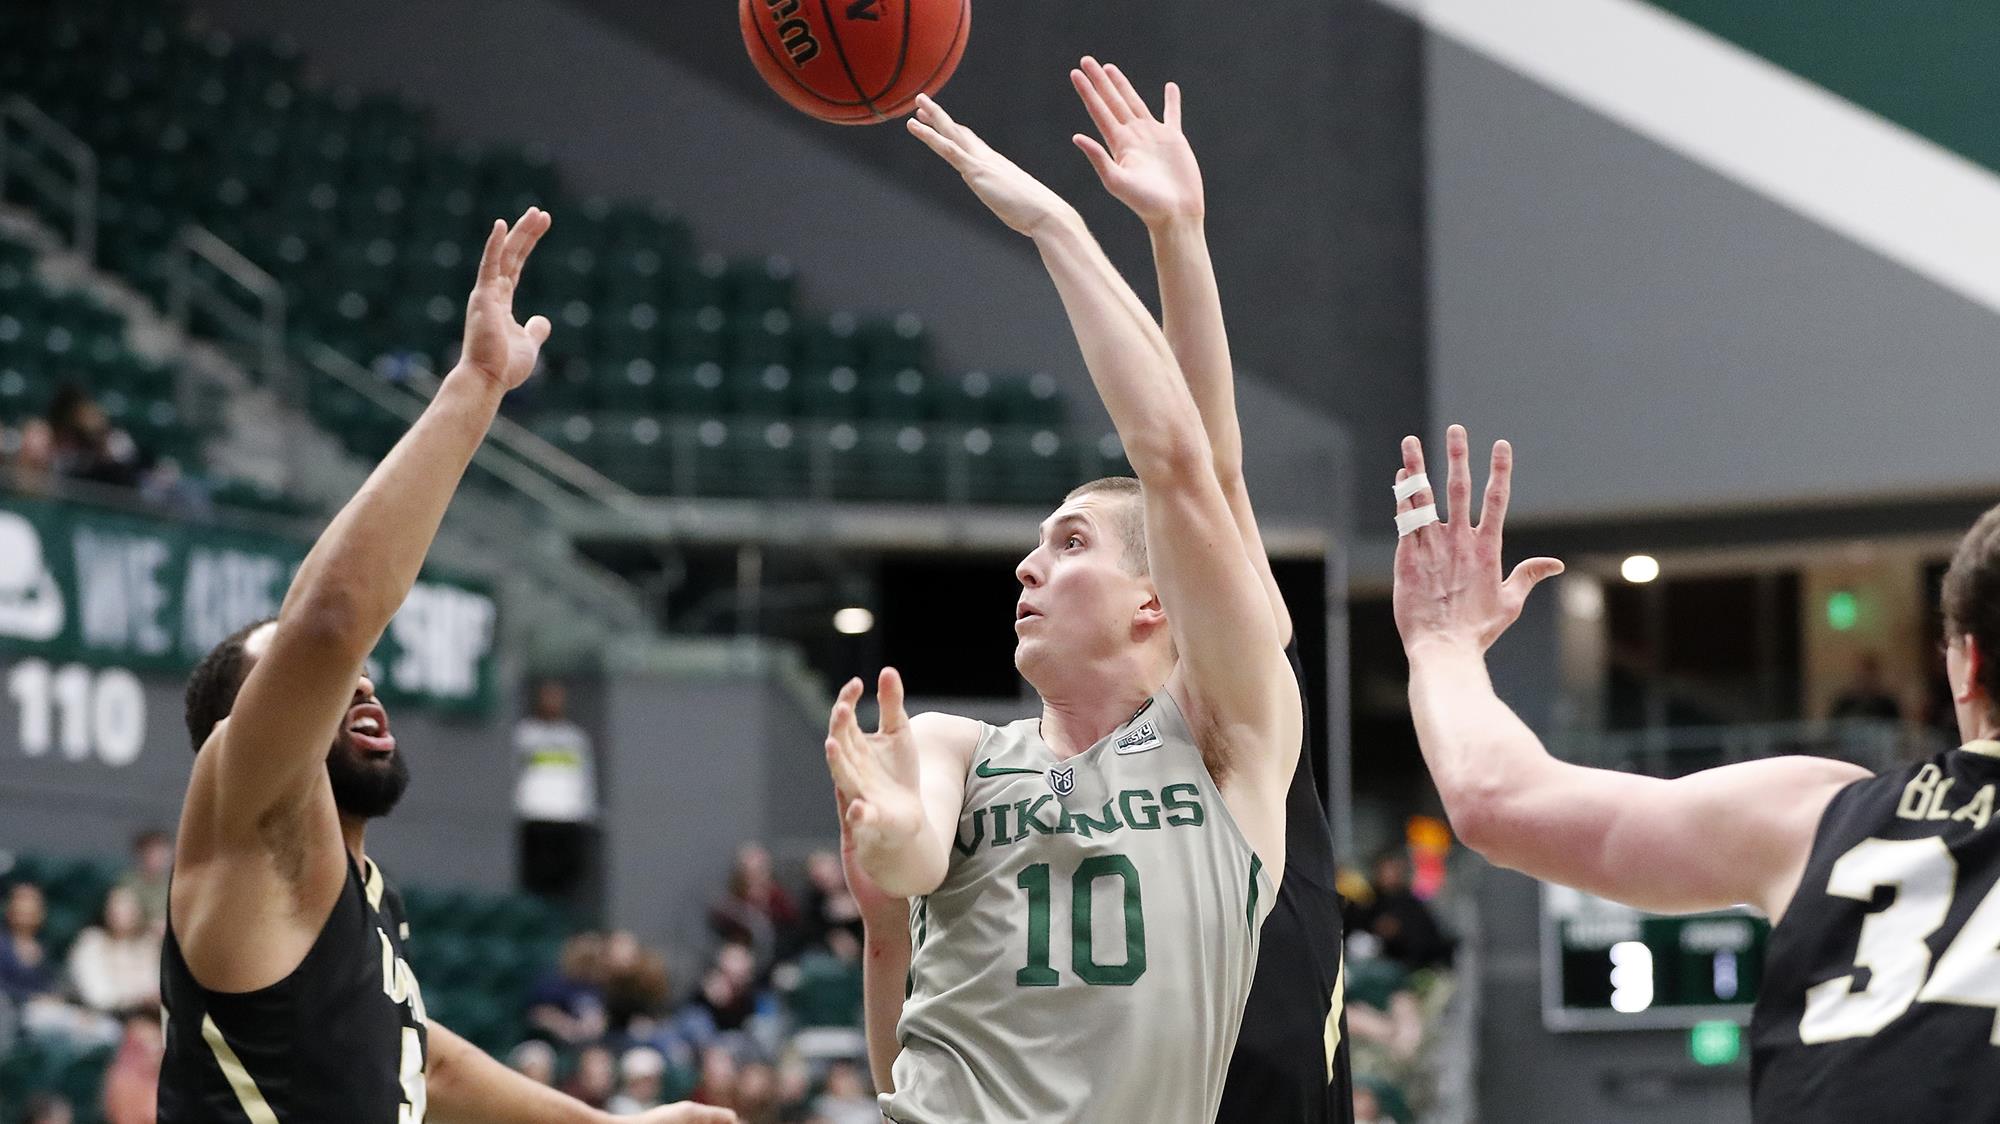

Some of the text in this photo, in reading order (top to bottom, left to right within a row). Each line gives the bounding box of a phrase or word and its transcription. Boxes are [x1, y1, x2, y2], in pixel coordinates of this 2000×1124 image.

[75, 525, 170, 655] WE
[10, 658, 145, 766] 110
[954, 783, 1204, 857] VIKINGS
[1896, 763, 2000, 830] BLA
[1016, 854, 1147, 986] 10
[1799, 835, 2000, 1045] 34
